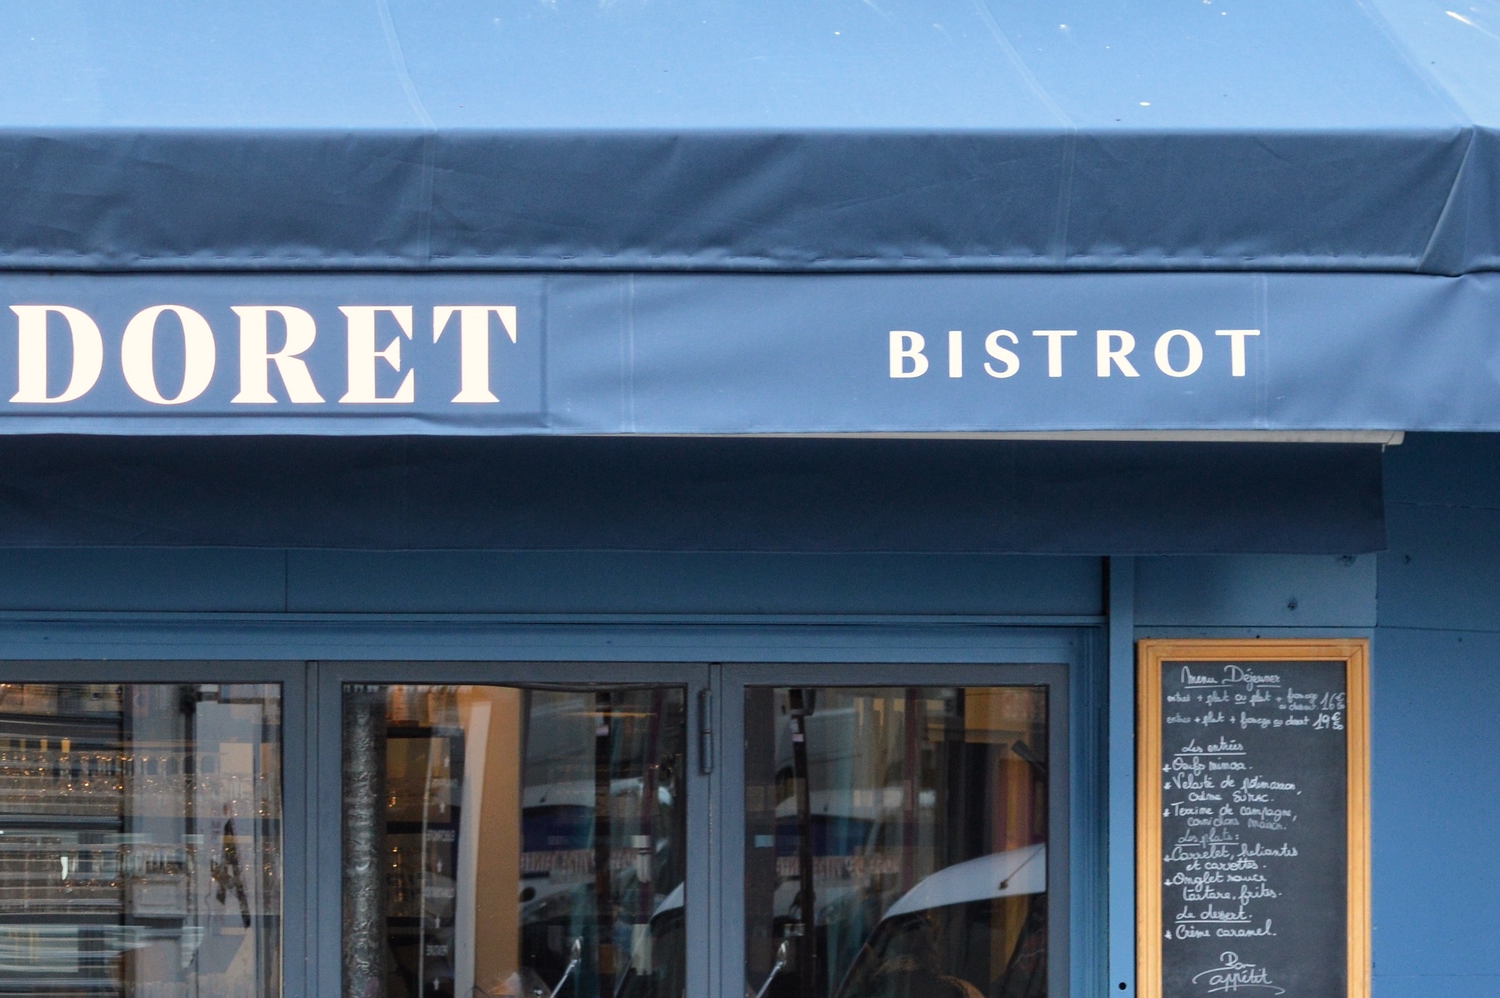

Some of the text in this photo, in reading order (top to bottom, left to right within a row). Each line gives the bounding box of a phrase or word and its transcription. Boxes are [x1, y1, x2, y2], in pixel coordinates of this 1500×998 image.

[888, 328, 1262, 379] BISTROT
[1181, 664, 1280, 691] Menu Déjeuner
[1182, 736, 1244, 752] Les entrées
[1220, 775, 1235, 789] de
[1219, 803, 1234, 817] de
[1178, 828, 1199, 843] Les
[1186, 860, 1201, 871] et
[1172, 871, 1224, 892] Onglet
[1176, 905, 1196, 920] Le
[1220, 951, 1256, 970] Bon
[1209, 968, 1273, 992] appétit
